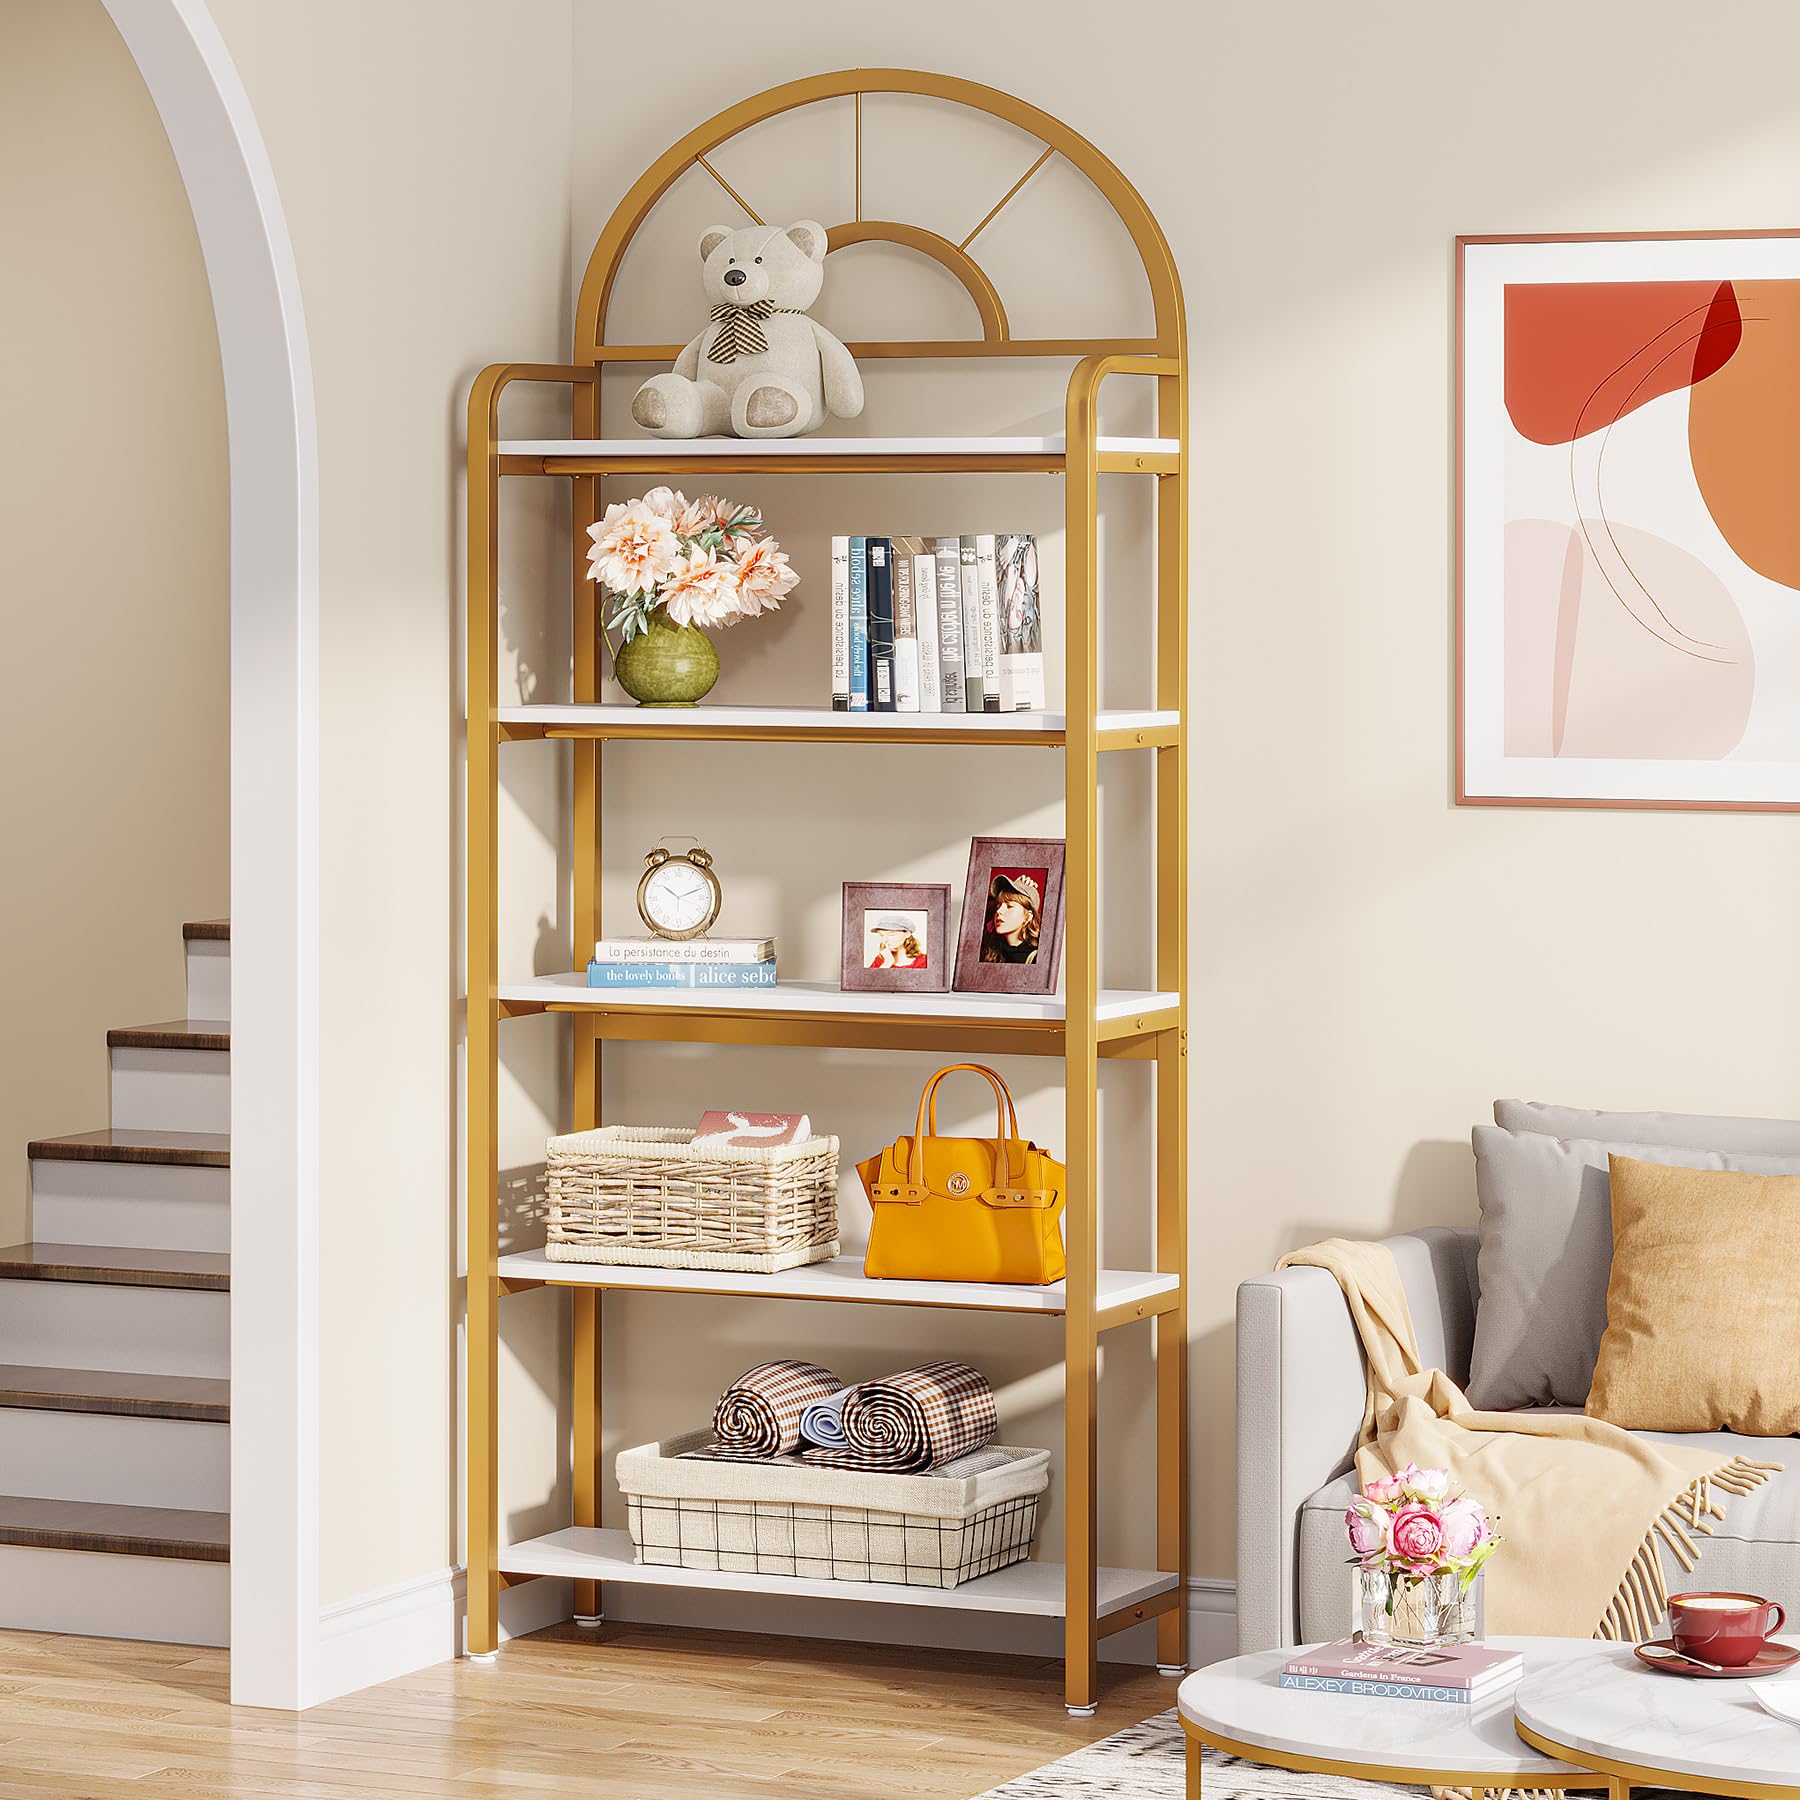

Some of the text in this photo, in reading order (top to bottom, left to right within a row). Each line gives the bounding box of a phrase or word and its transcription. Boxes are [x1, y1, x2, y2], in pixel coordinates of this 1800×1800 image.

[609, 946, 730, 962] La persistance du destin
[606, 969, 623, 981] the
[625, 969, 653, 984] lovely
[699, 967, 737, 984] alice
[1341, 1669, 1422, 1683] Gardens in France
[1283, 1676, 1460, 1702] ALEXEY BRODOVITCH
